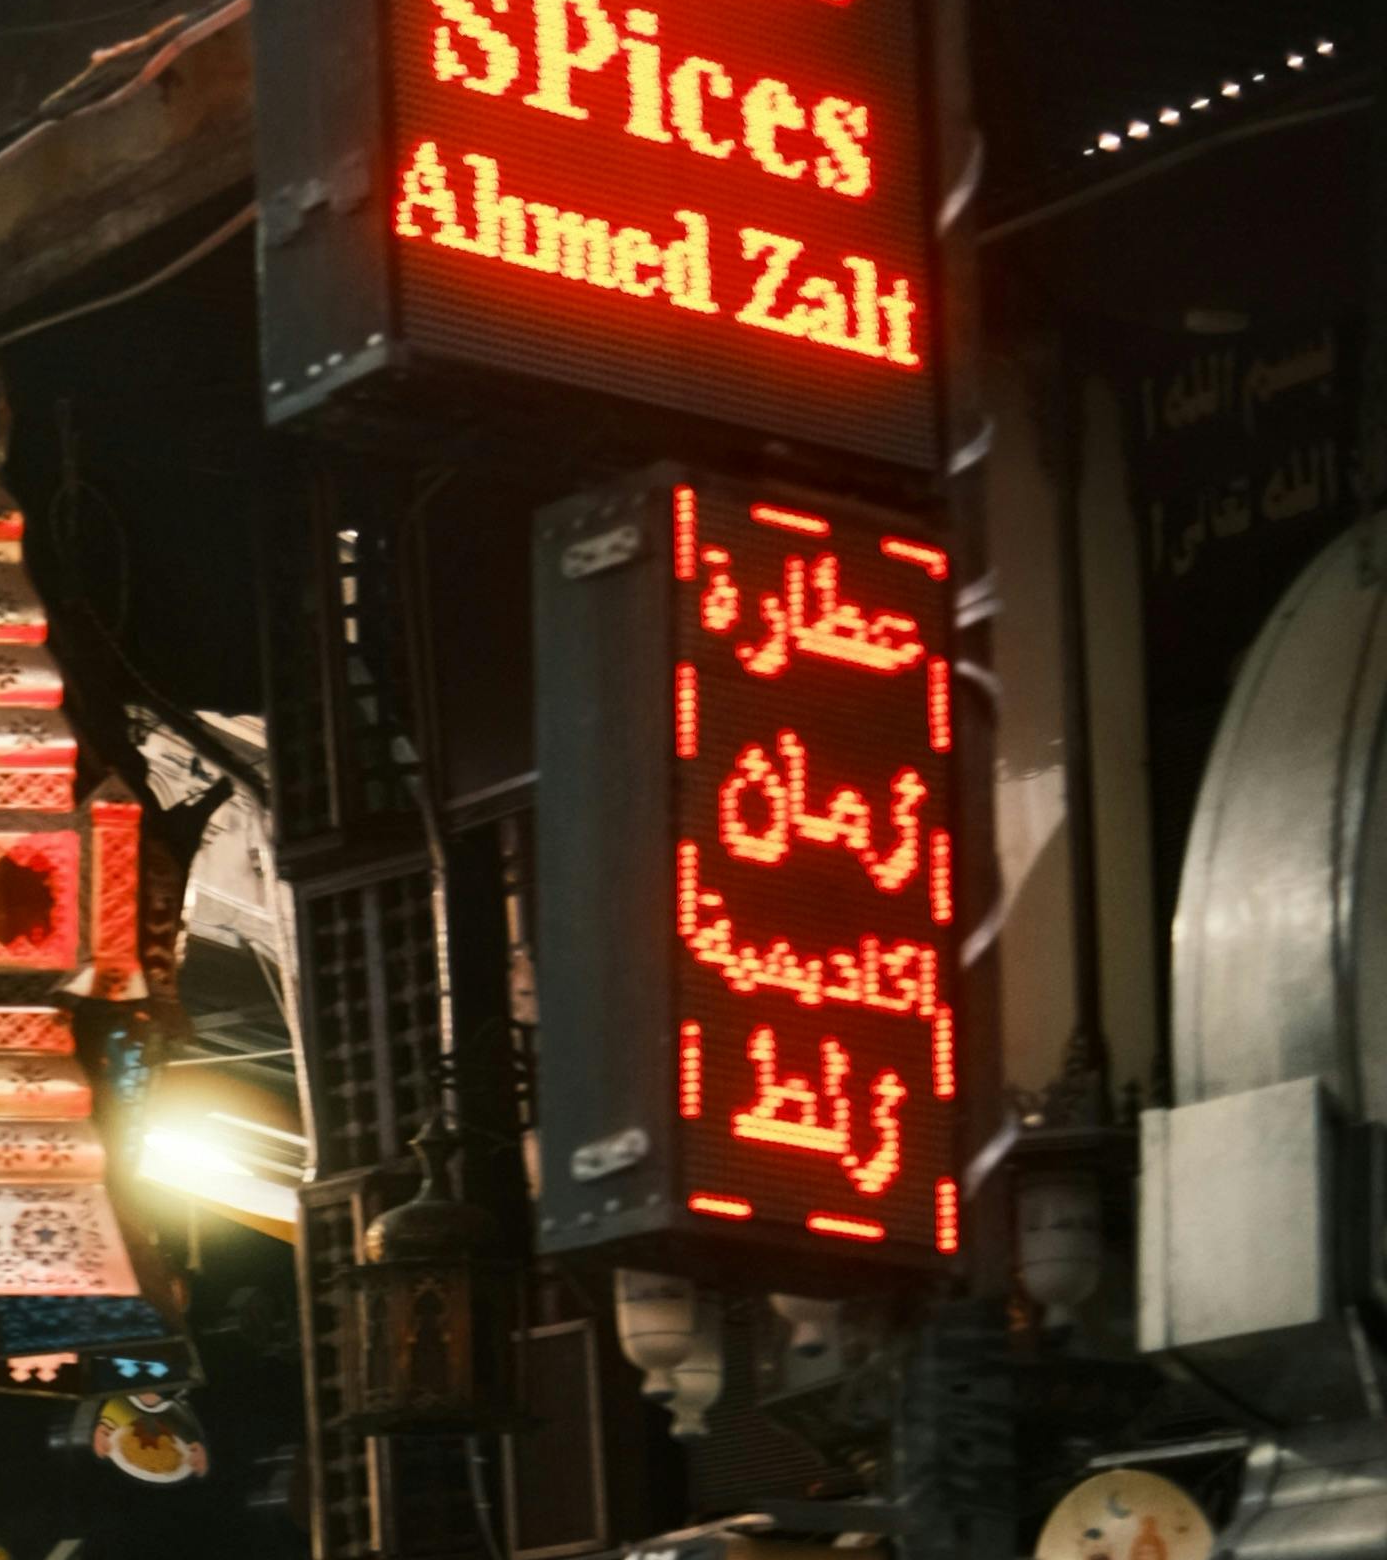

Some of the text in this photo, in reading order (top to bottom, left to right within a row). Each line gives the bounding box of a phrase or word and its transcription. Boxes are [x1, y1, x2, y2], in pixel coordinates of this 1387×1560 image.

[396, 140, 920, 367] Ahmed Zalt
[701, 548, 926, 676] عطارة
[721, 729, 927, 890] زمان
[732, 1026, 907, 1195] زلط
